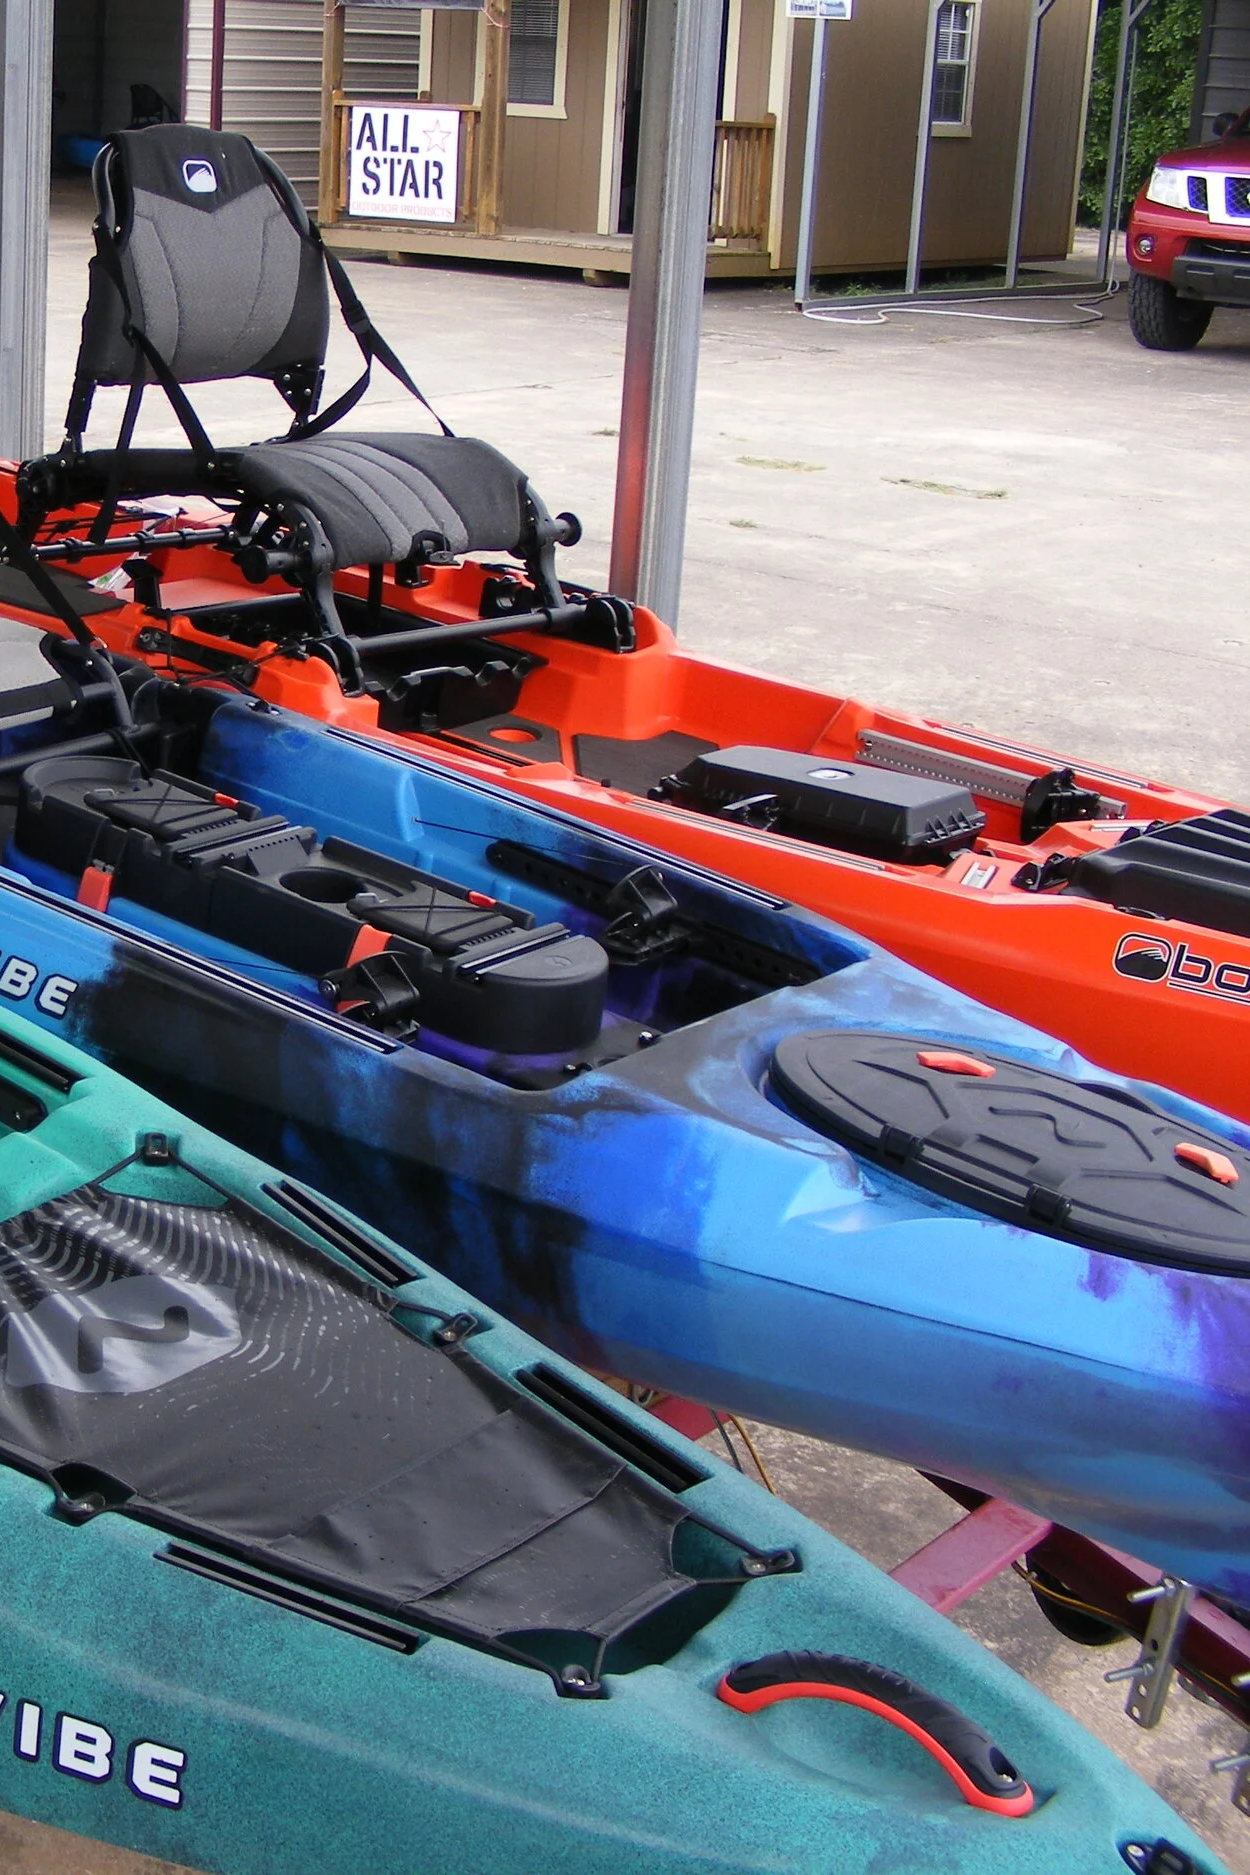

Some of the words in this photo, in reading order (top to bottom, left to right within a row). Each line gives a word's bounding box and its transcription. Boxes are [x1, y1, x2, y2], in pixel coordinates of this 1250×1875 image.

[356, 113, 419, 153] ALL
[362, 156, 443, 199] STAR
[352, 201, 398, 213] OUTDOOR
[400, 205, 453, 217] PRODUCTS
